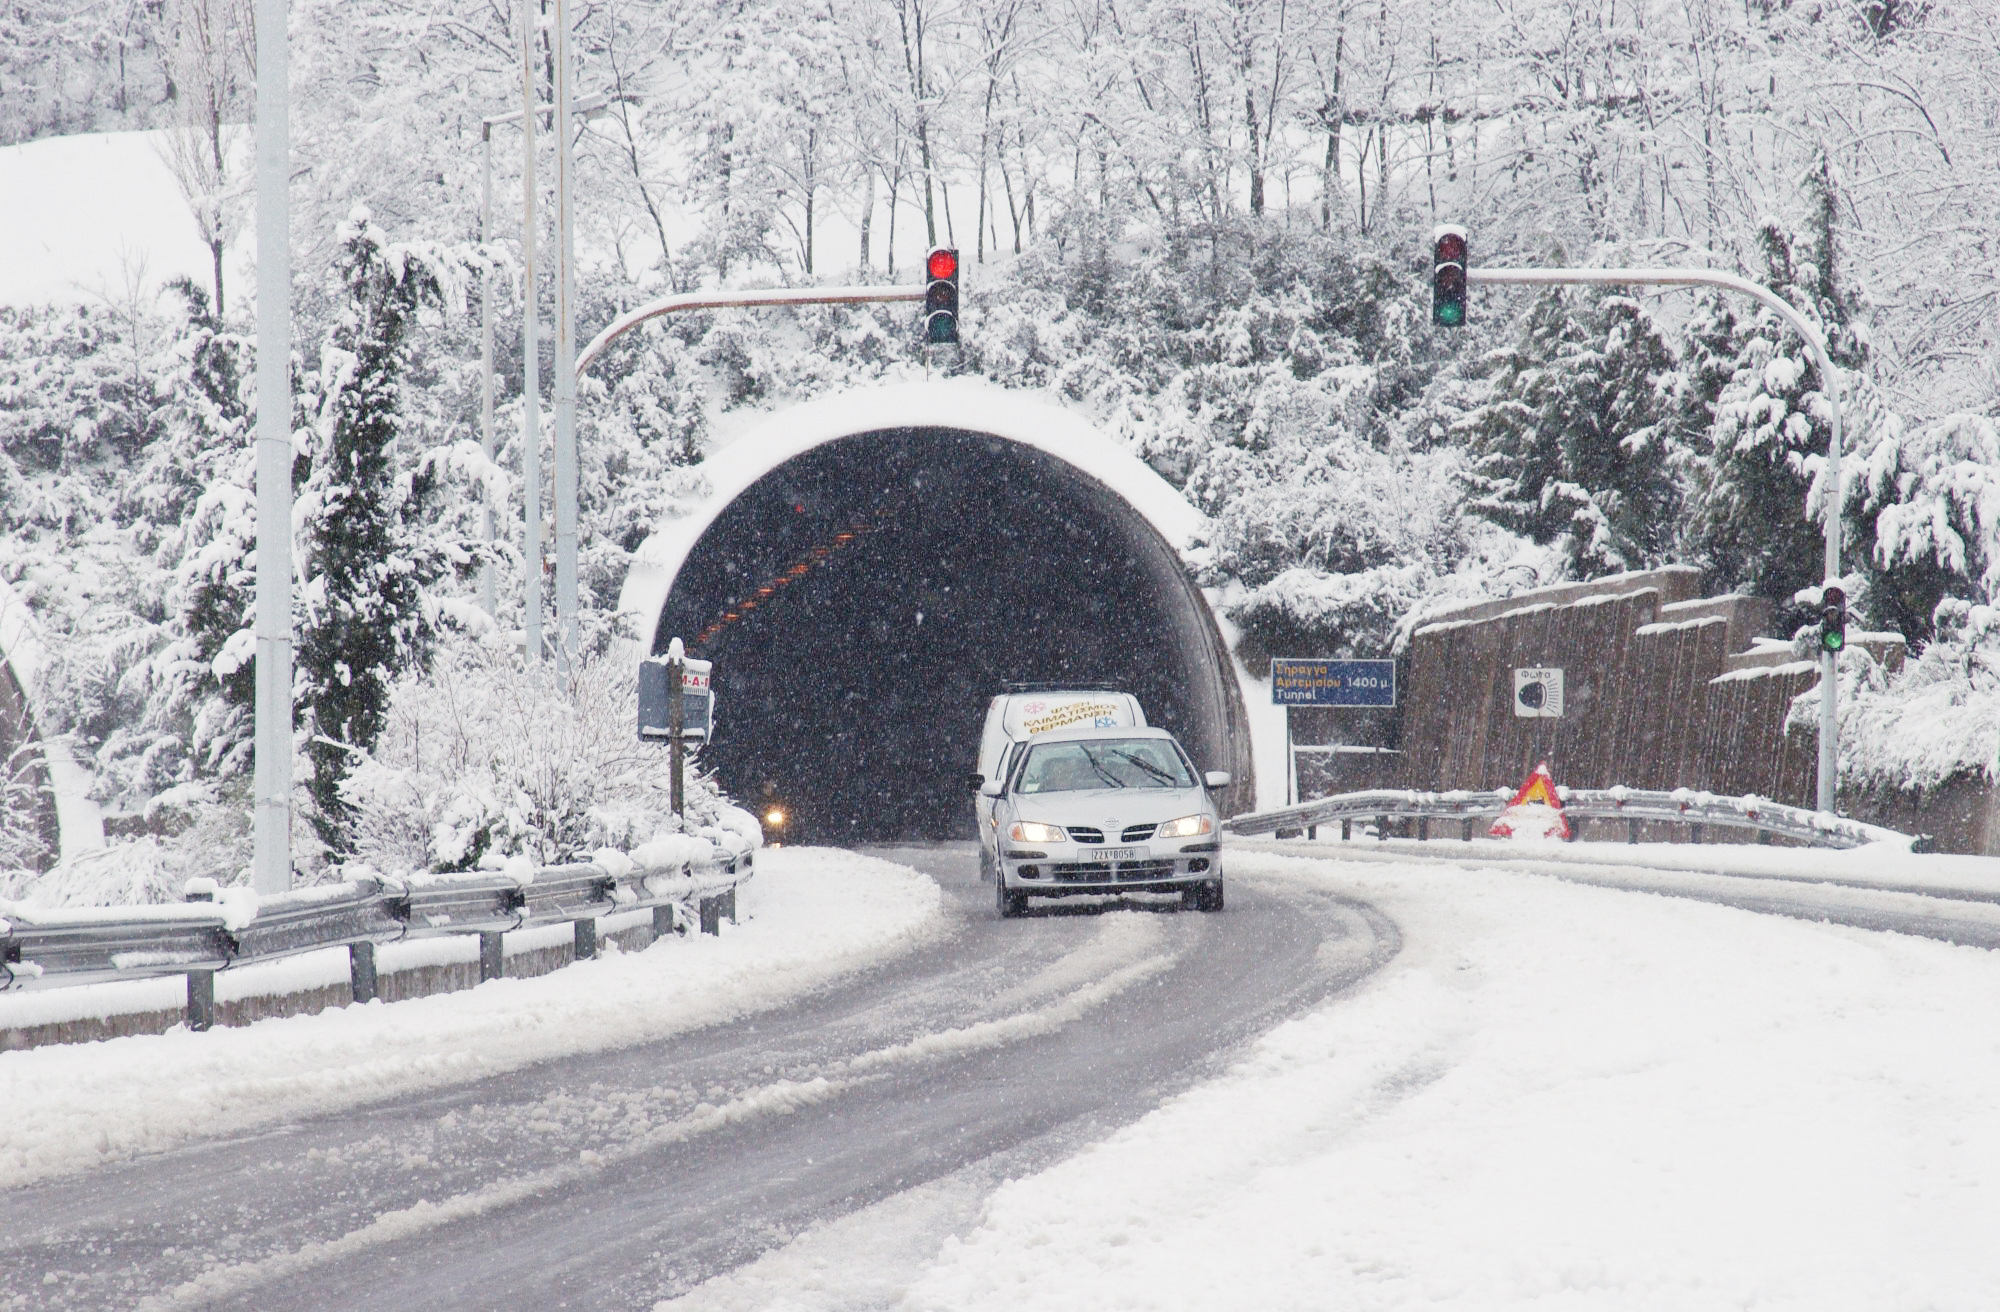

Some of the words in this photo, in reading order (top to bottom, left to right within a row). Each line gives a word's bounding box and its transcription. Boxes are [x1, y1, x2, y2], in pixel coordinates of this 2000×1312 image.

[1348, 677, 1378, 688] 1400
[1276, 687, 1317, 700] Tunnel
[1023, 703, 1119, 727] ΚΛΙΜΑΤΙΣΜΟΣ
[1030, 709, 1112, 734] ΘΕΡΜΑΝΣΗ
